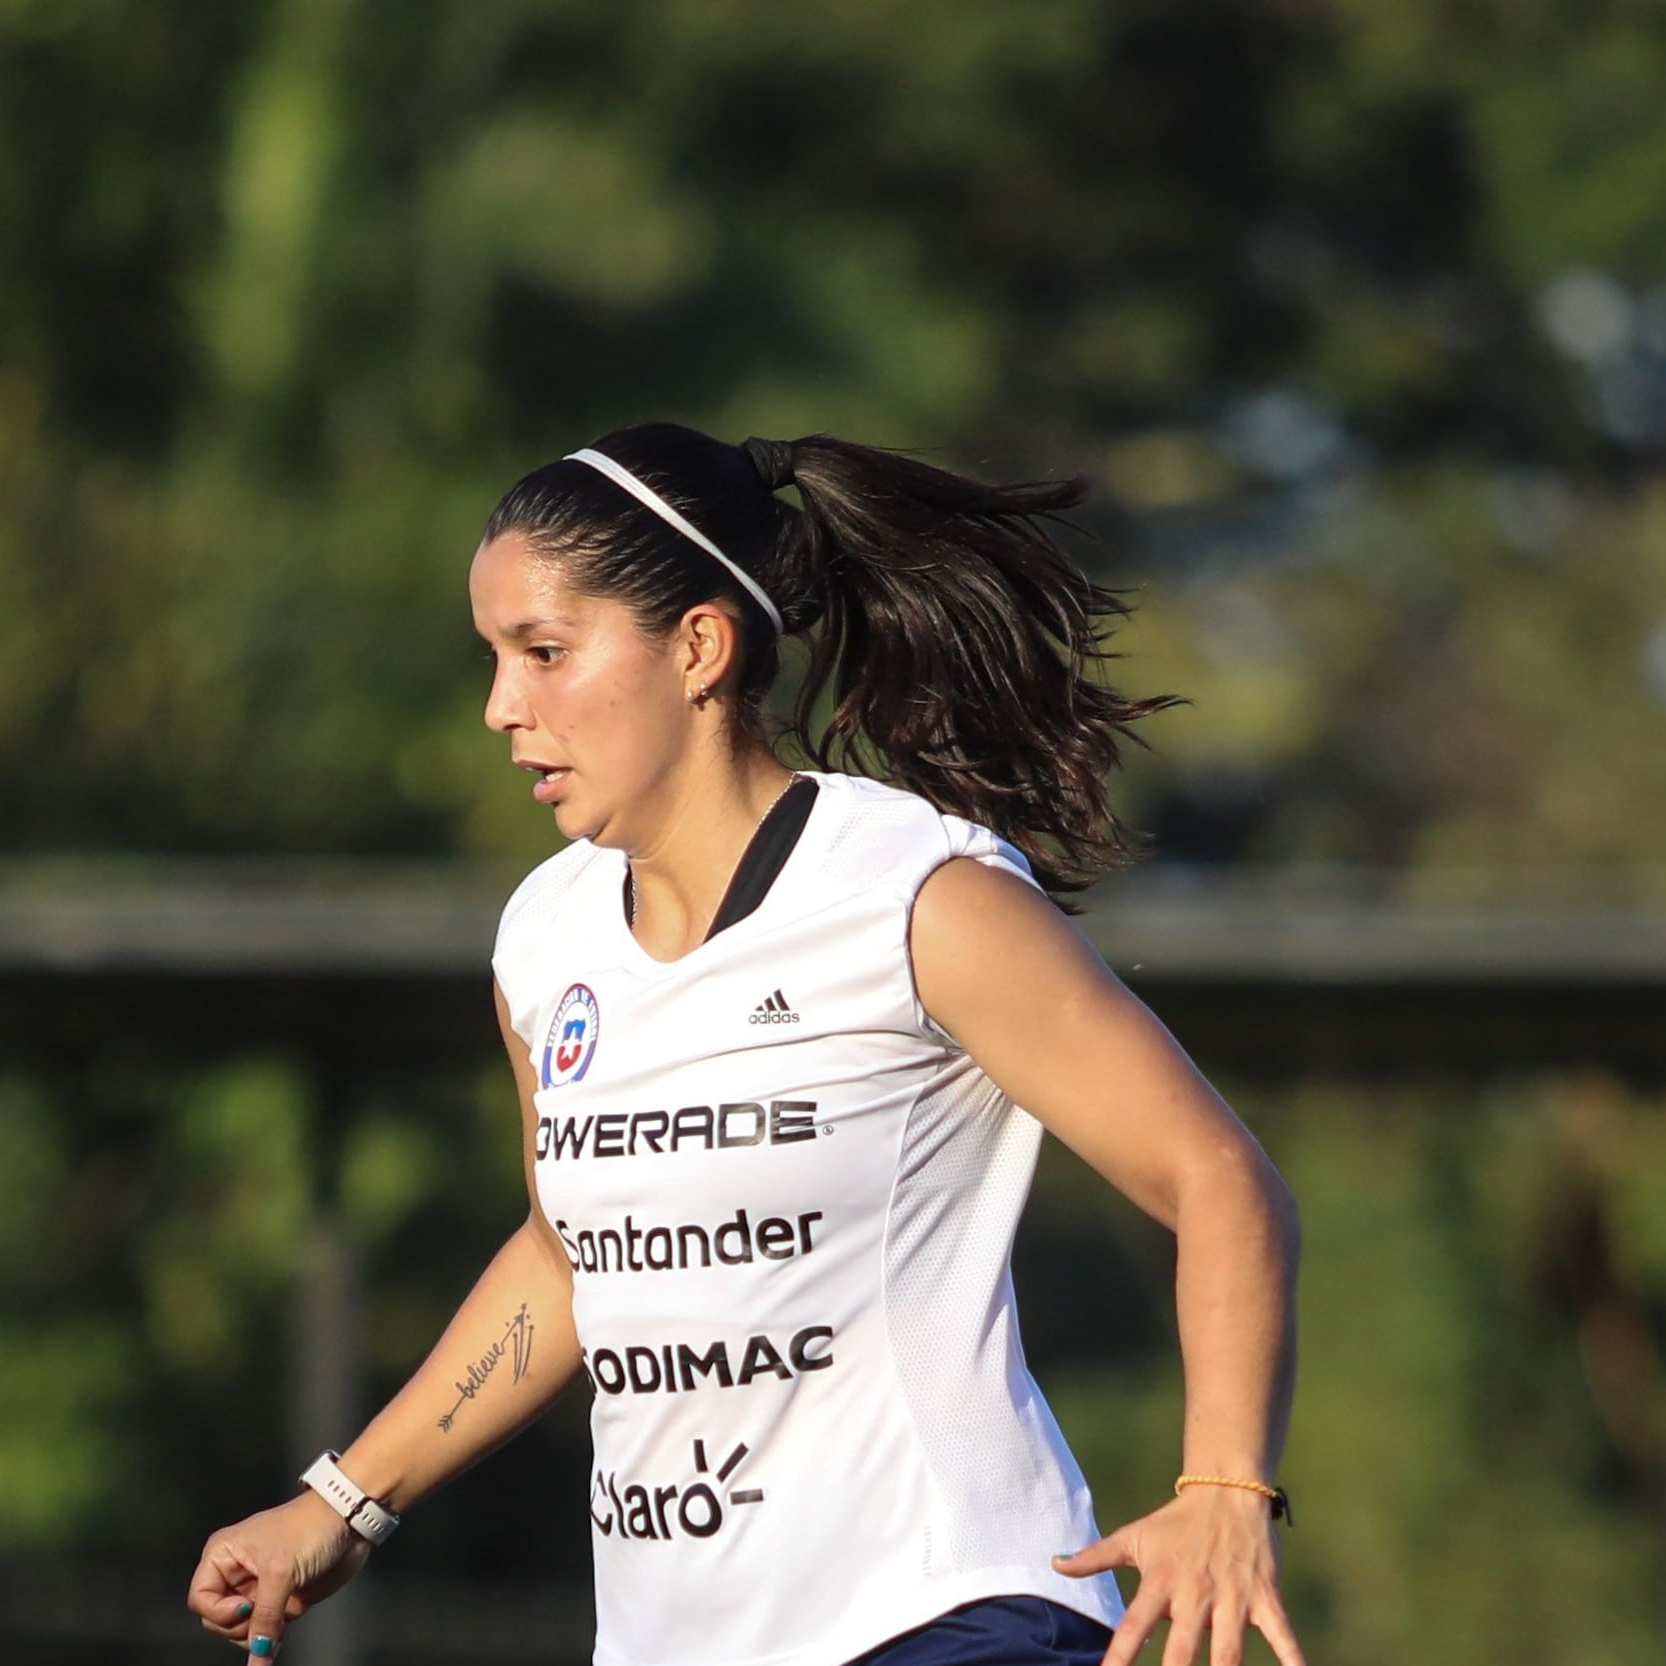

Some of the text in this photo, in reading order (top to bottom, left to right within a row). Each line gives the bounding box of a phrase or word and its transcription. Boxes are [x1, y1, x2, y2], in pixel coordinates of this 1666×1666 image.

[748, 1010, 800, 1025] adidas
[536, 1100, 818, 1162] OWERADE
[555, 1208, 823, 1274] Santander
[455, 1341, 506, 1400] believe
[590, 1469, 723, 1540] Claro
